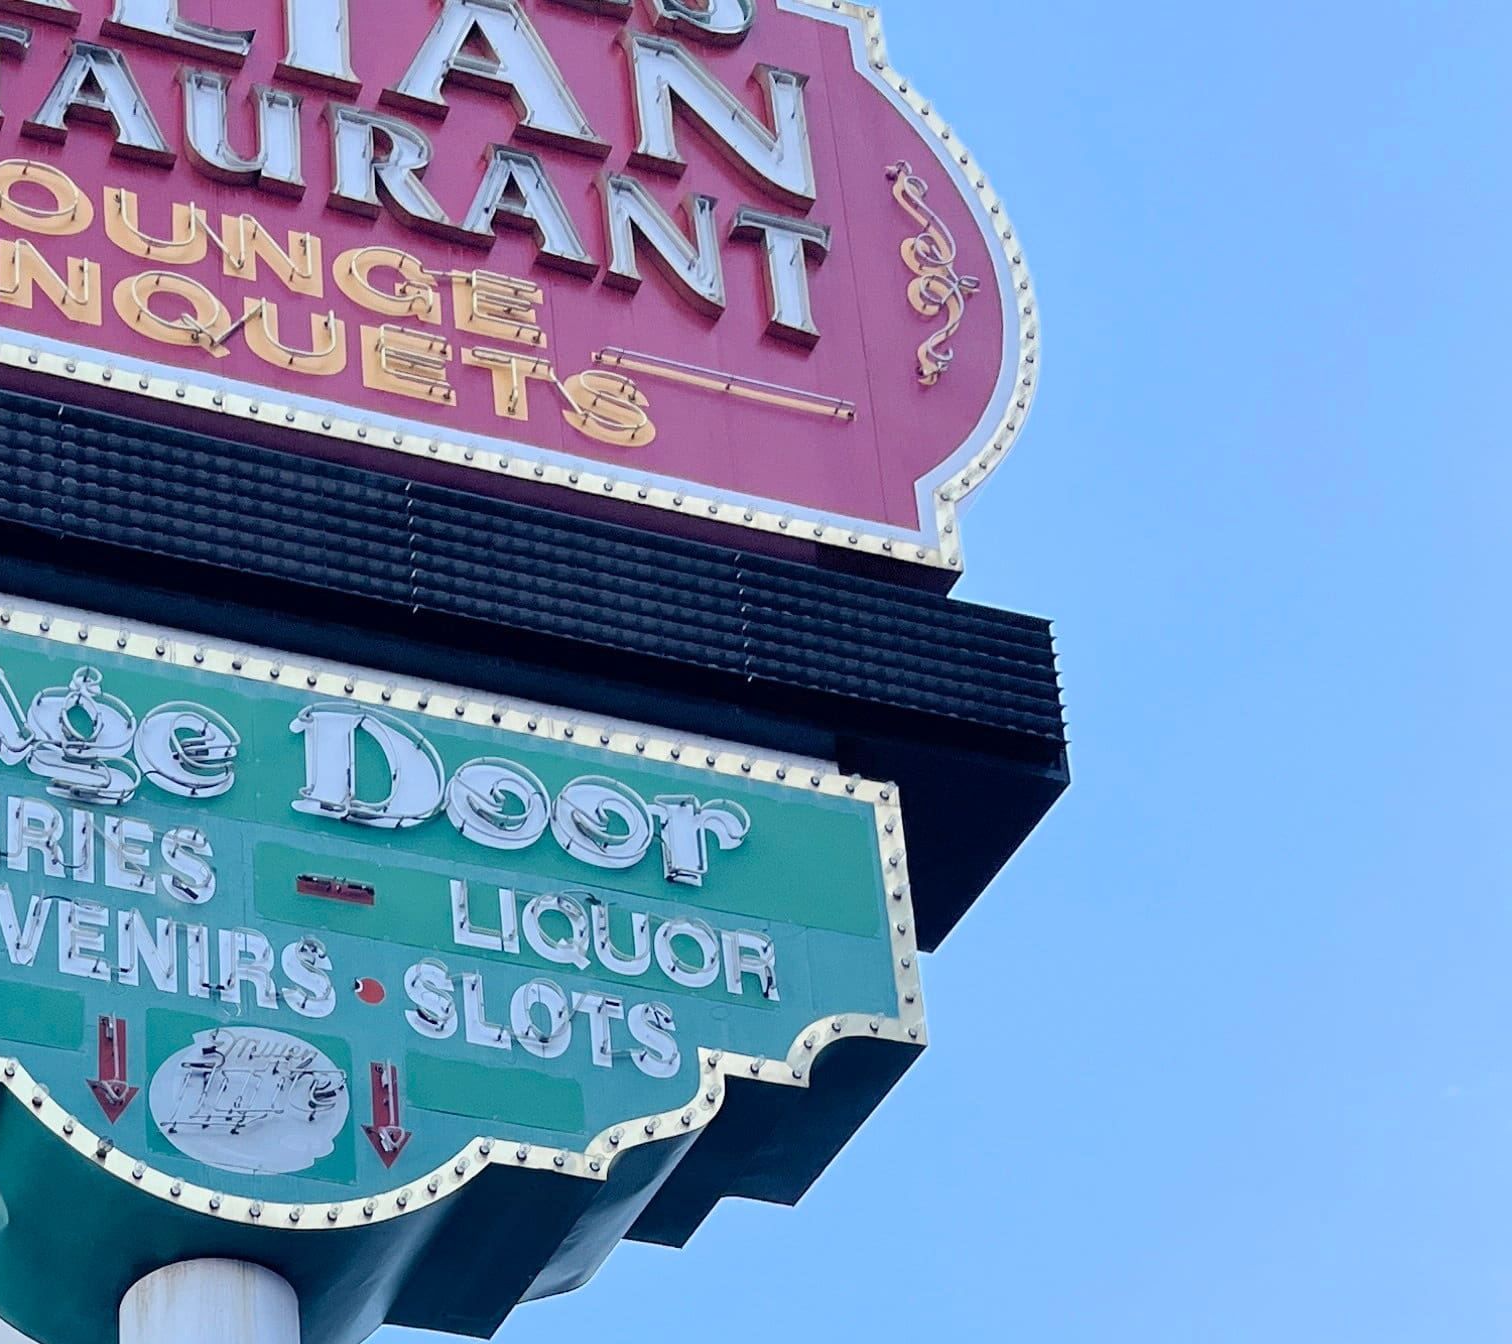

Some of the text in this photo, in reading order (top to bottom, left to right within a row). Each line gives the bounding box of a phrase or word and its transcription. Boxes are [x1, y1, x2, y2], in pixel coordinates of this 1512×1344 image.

[289, 701, 752, 887] Door
[449, 879, 779, 1001] LIQUOR
[404, 958, 681, 1078] SLOTS
